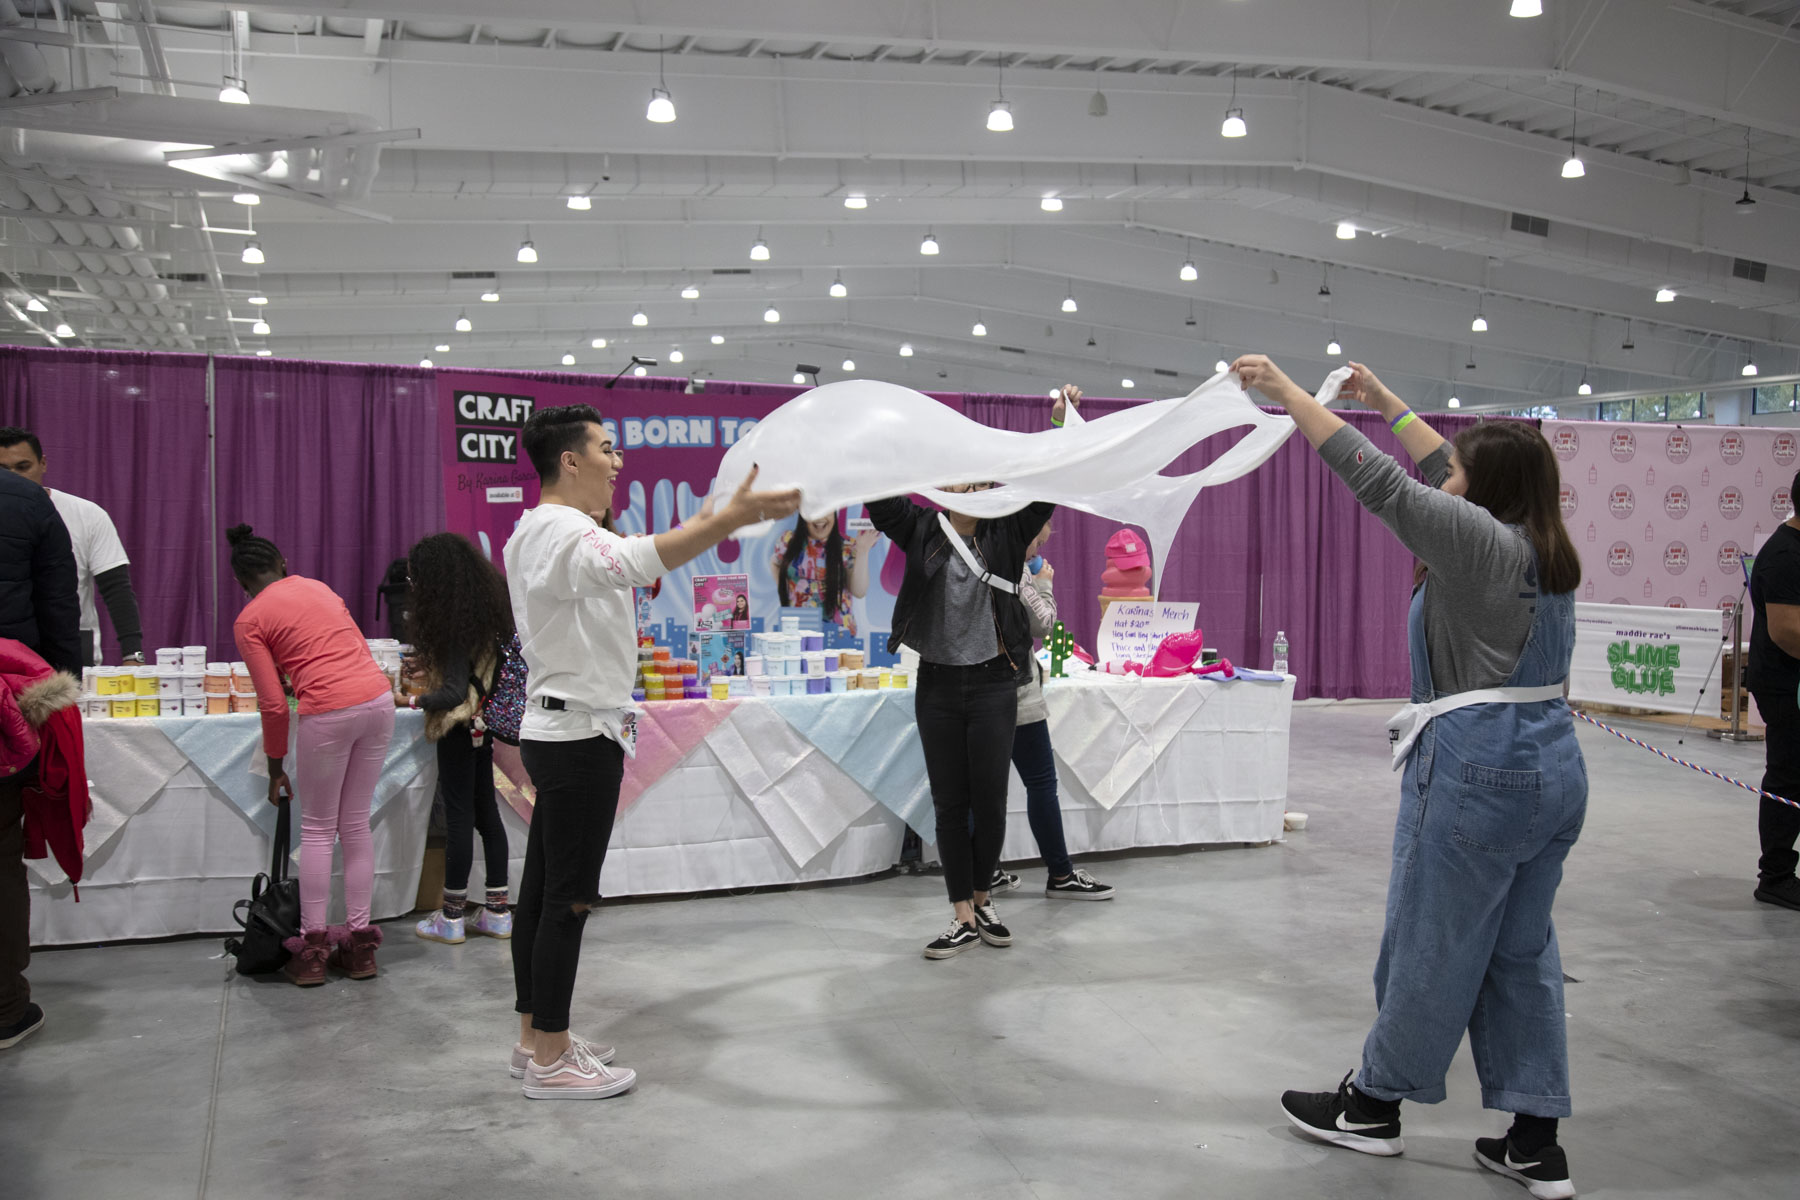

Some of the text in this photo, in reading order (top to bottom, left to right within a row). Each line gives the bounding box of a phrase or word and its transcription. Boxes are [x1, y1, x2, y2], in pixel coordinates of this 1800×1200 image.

[459, 394, 533, 423] CRAFT
[461, 432, 516, 460] CITY
[624, 418, 713, 446] BORN
[457, 473, 473, 493] By
[475, 471, 508, 490] Karina
[1114, 620, 1128, 628] Hat
[1161, 607, 1190, 620] Merch
[1615, 630, 1671, 640] maddie rae's
[1607, 640, 1680, 670] SLIME
[1611, 667, 1676, 697] GLUE
